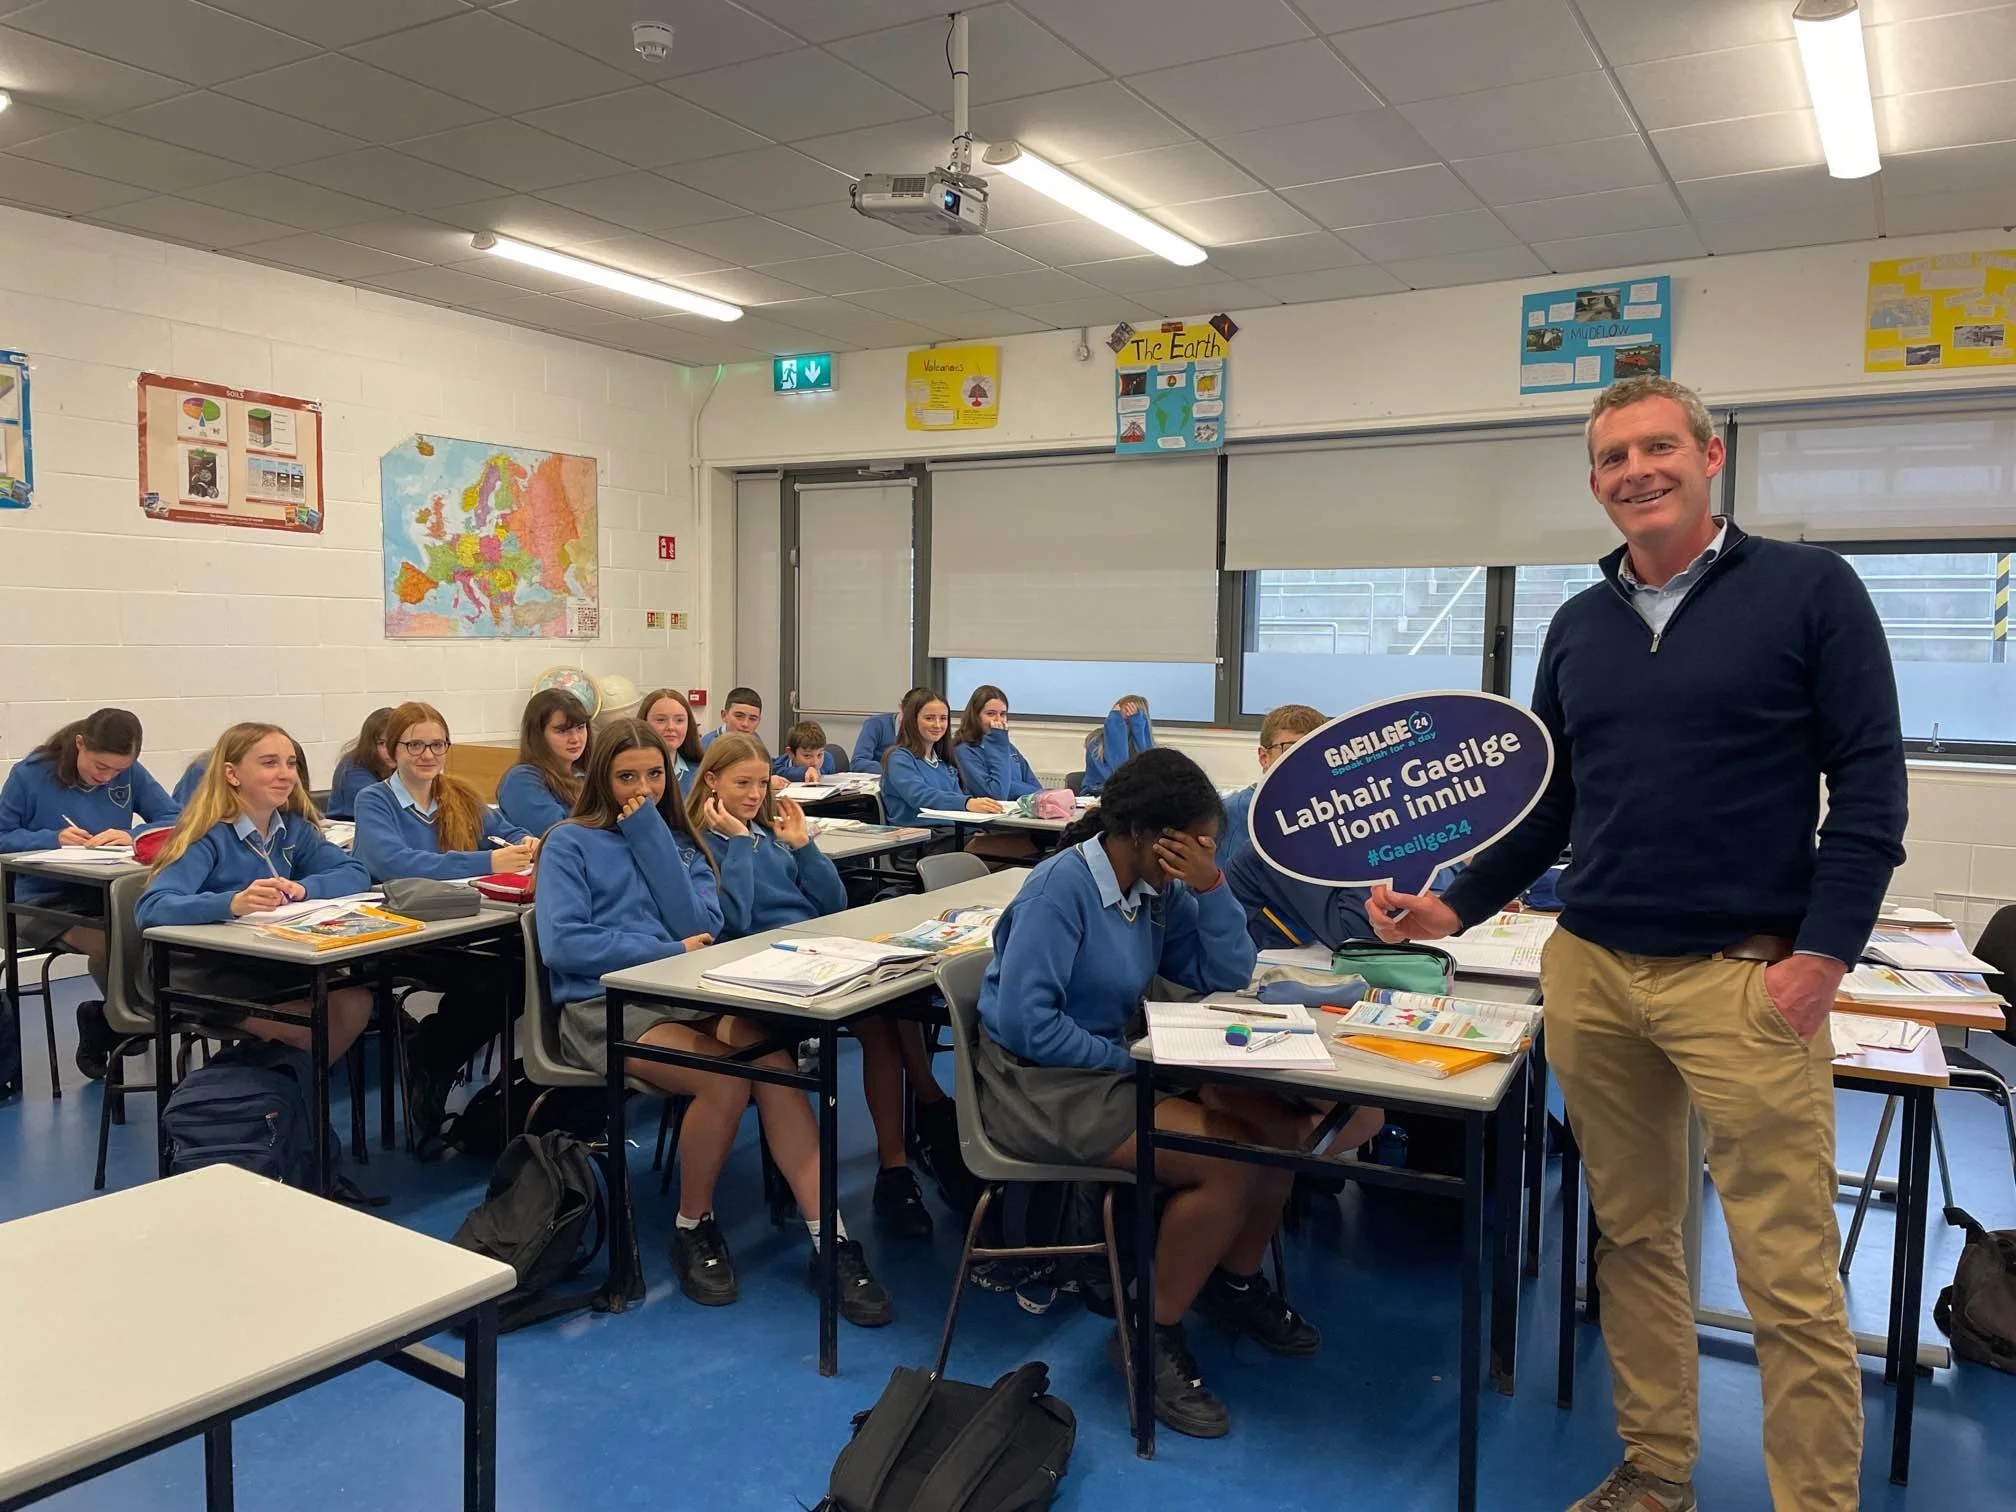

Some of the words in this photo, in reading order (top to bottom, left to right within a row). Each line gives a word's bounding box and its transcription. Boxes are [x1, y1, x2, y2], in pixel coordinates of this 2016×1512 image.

[1131, 338, 1162, 360] The
[1170, 333, 1220, 359] Earth
[226, 390, 245, 399] SOILS
[1324, 719, 1412, 768] GAEILGE
[1413, 716, 1429, 729] 24
[1331, 759, 1364, 776] Speak
[1365, 749, 1388, 763] Irish
[1389, 743, 1405, 754] for
[1408, 740, 1416, 748] a
[1417, 731, 1437, 743] day
[1274, 776, 1393, 836] Labhair
[1401, 730, 1522, 789] Gaeilge
[1328, 804, 1400, 848] liom
[1403, 775, 1487, 820] inniu
[1367, 819, 1473, 867] #Gaeilge24
